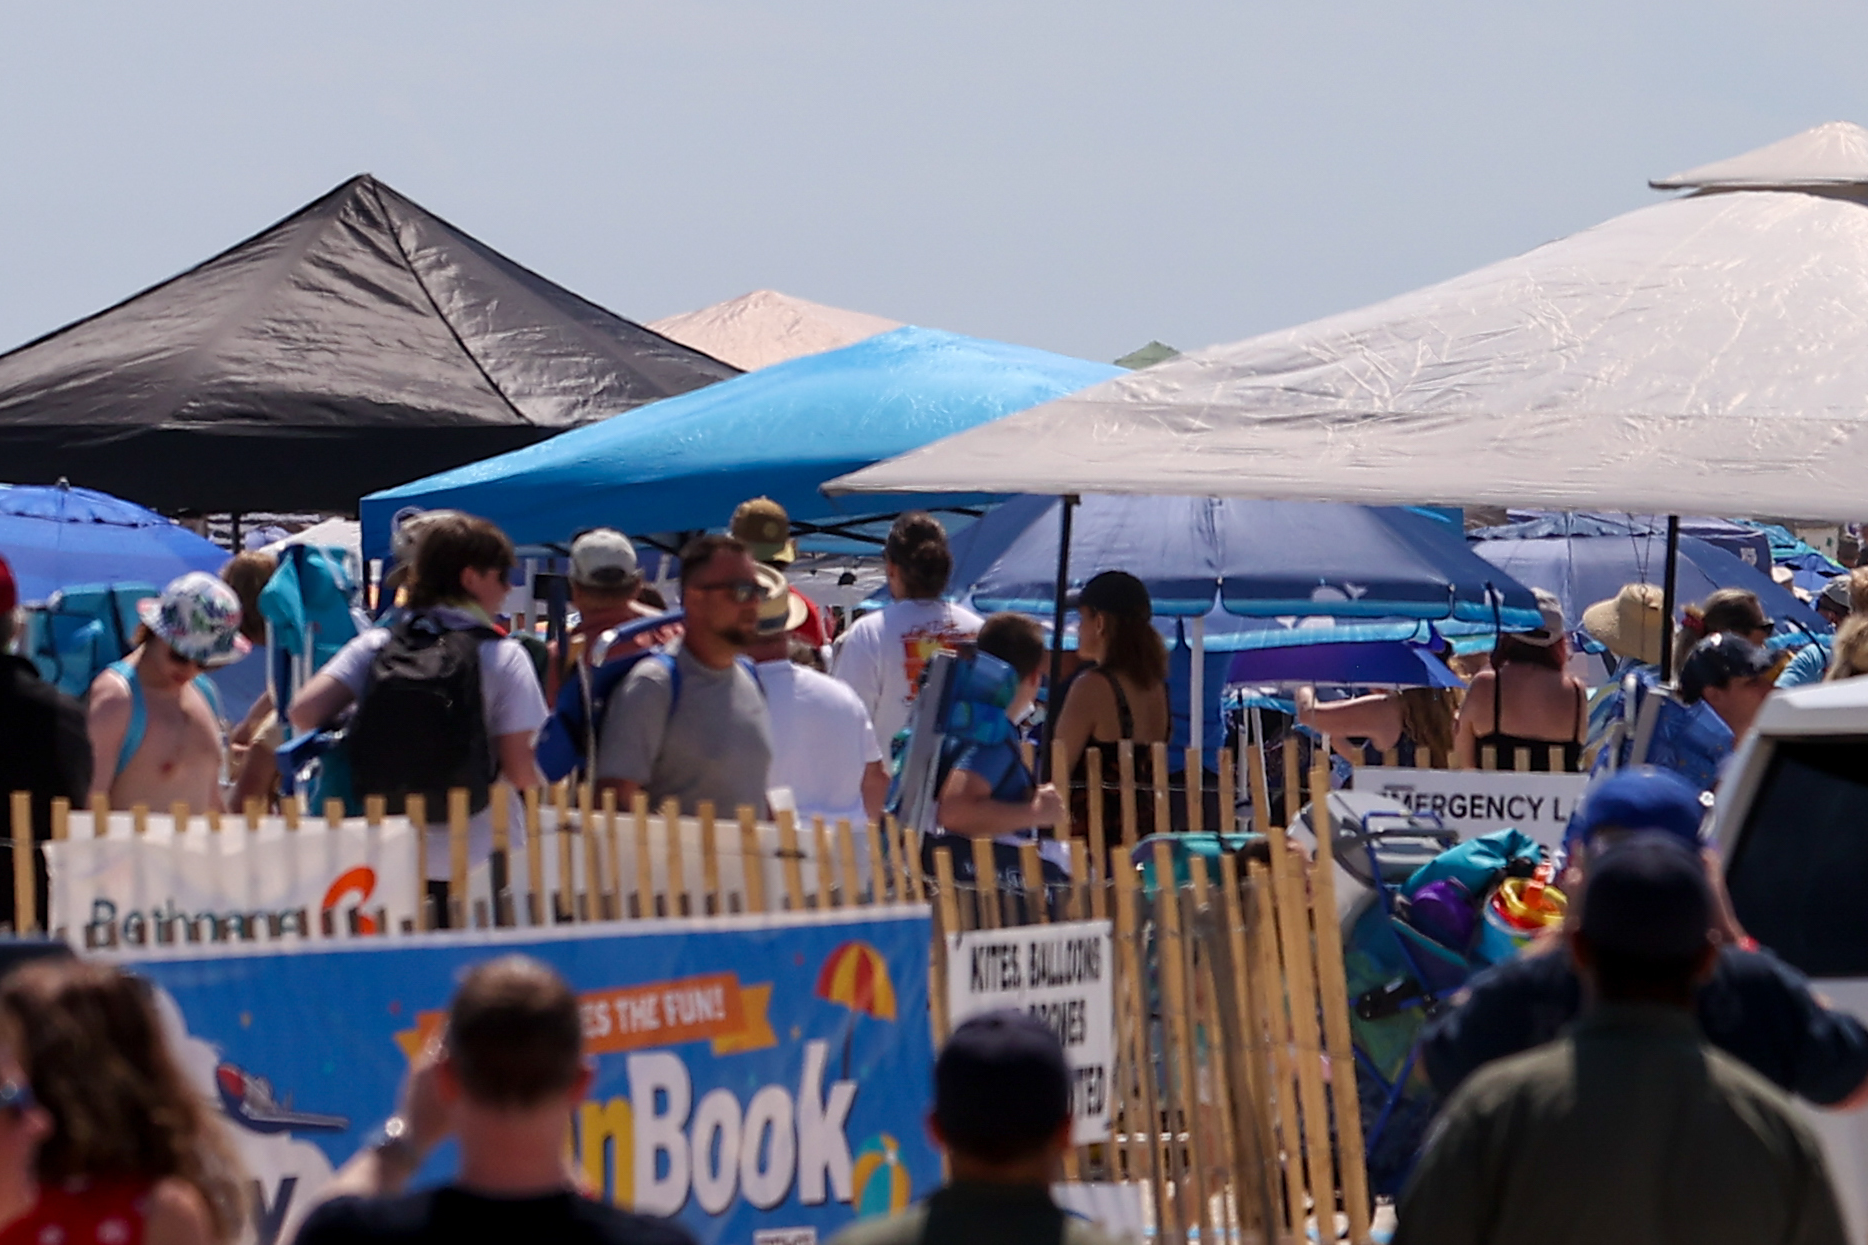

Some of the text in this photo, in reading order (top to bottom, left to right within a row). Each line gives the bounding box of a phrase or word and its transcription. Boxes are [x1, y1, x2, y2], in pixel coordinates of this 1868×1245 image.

[1030, 933, 1101, 988] BALLOONS
[614, 992, 662, 1035] THE
[663, 982, 727, 1027] FUN!
[570, 1039, 859, 1219] nBook
